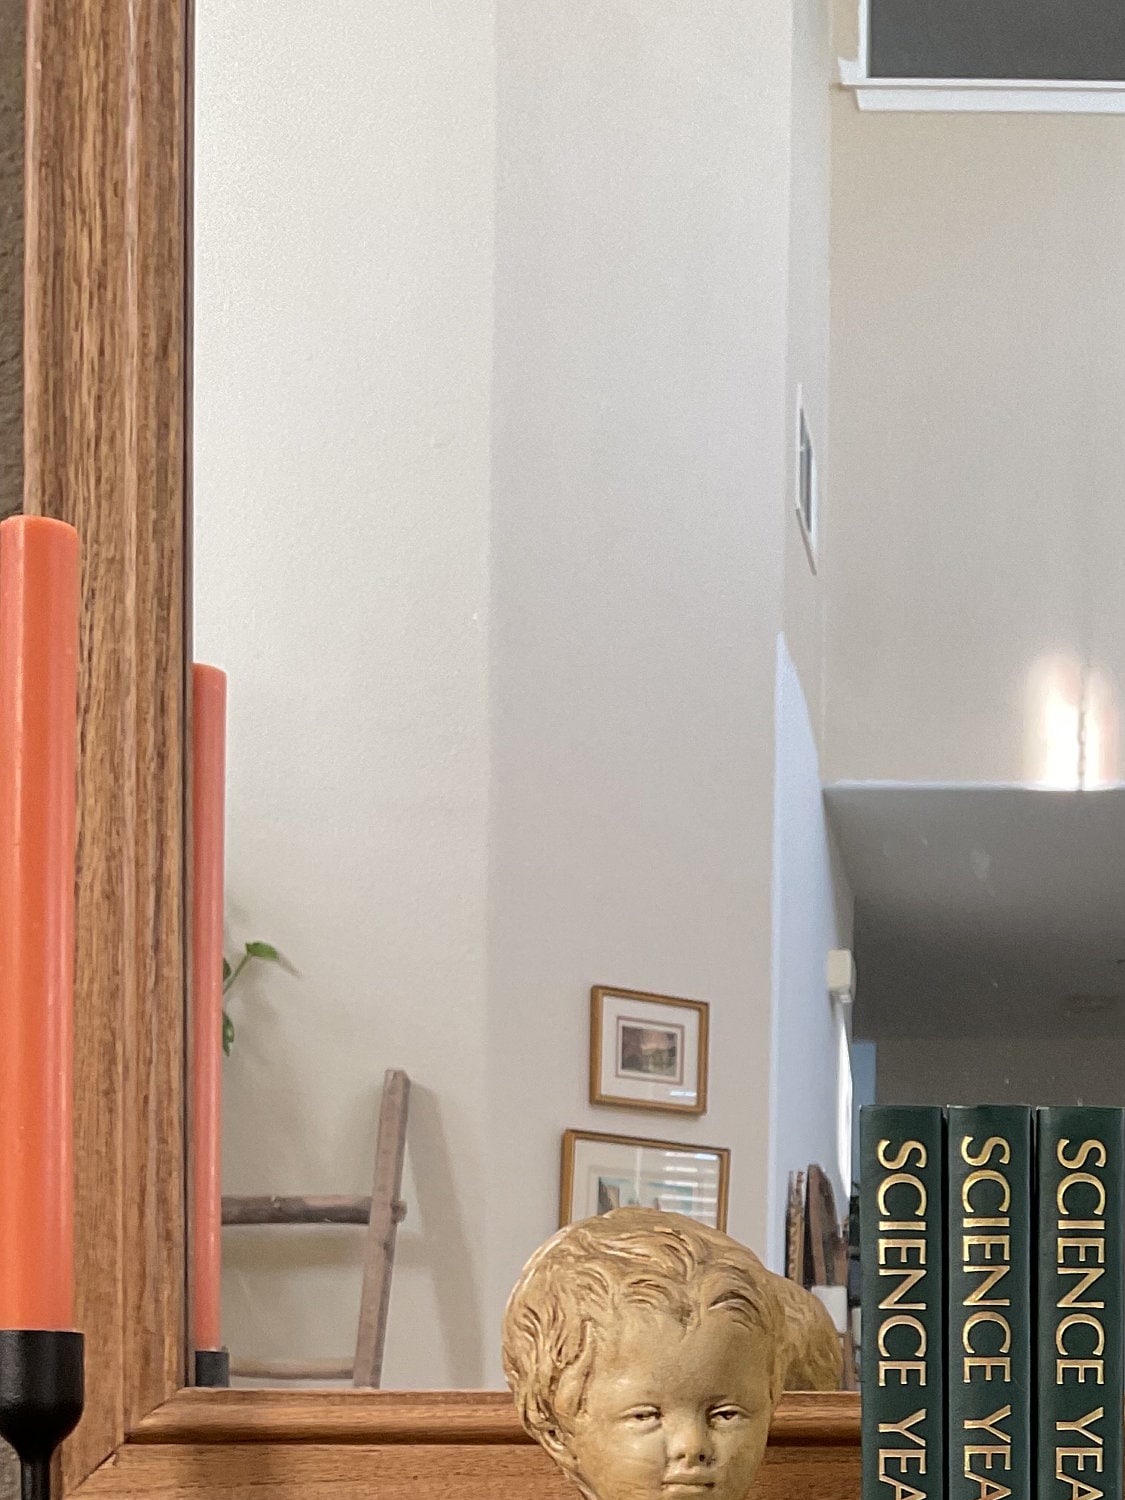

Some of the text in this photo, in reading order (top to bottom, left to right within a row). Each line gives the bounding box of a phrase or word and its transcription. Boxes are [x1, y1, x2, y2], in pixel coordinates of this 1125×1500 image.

[876, 1138, 928, 1387] SCIENCE
[960, 1135, 1012, 1384] SCIENCE
[1055, 1138, 1107, 1385] SCIENCE
